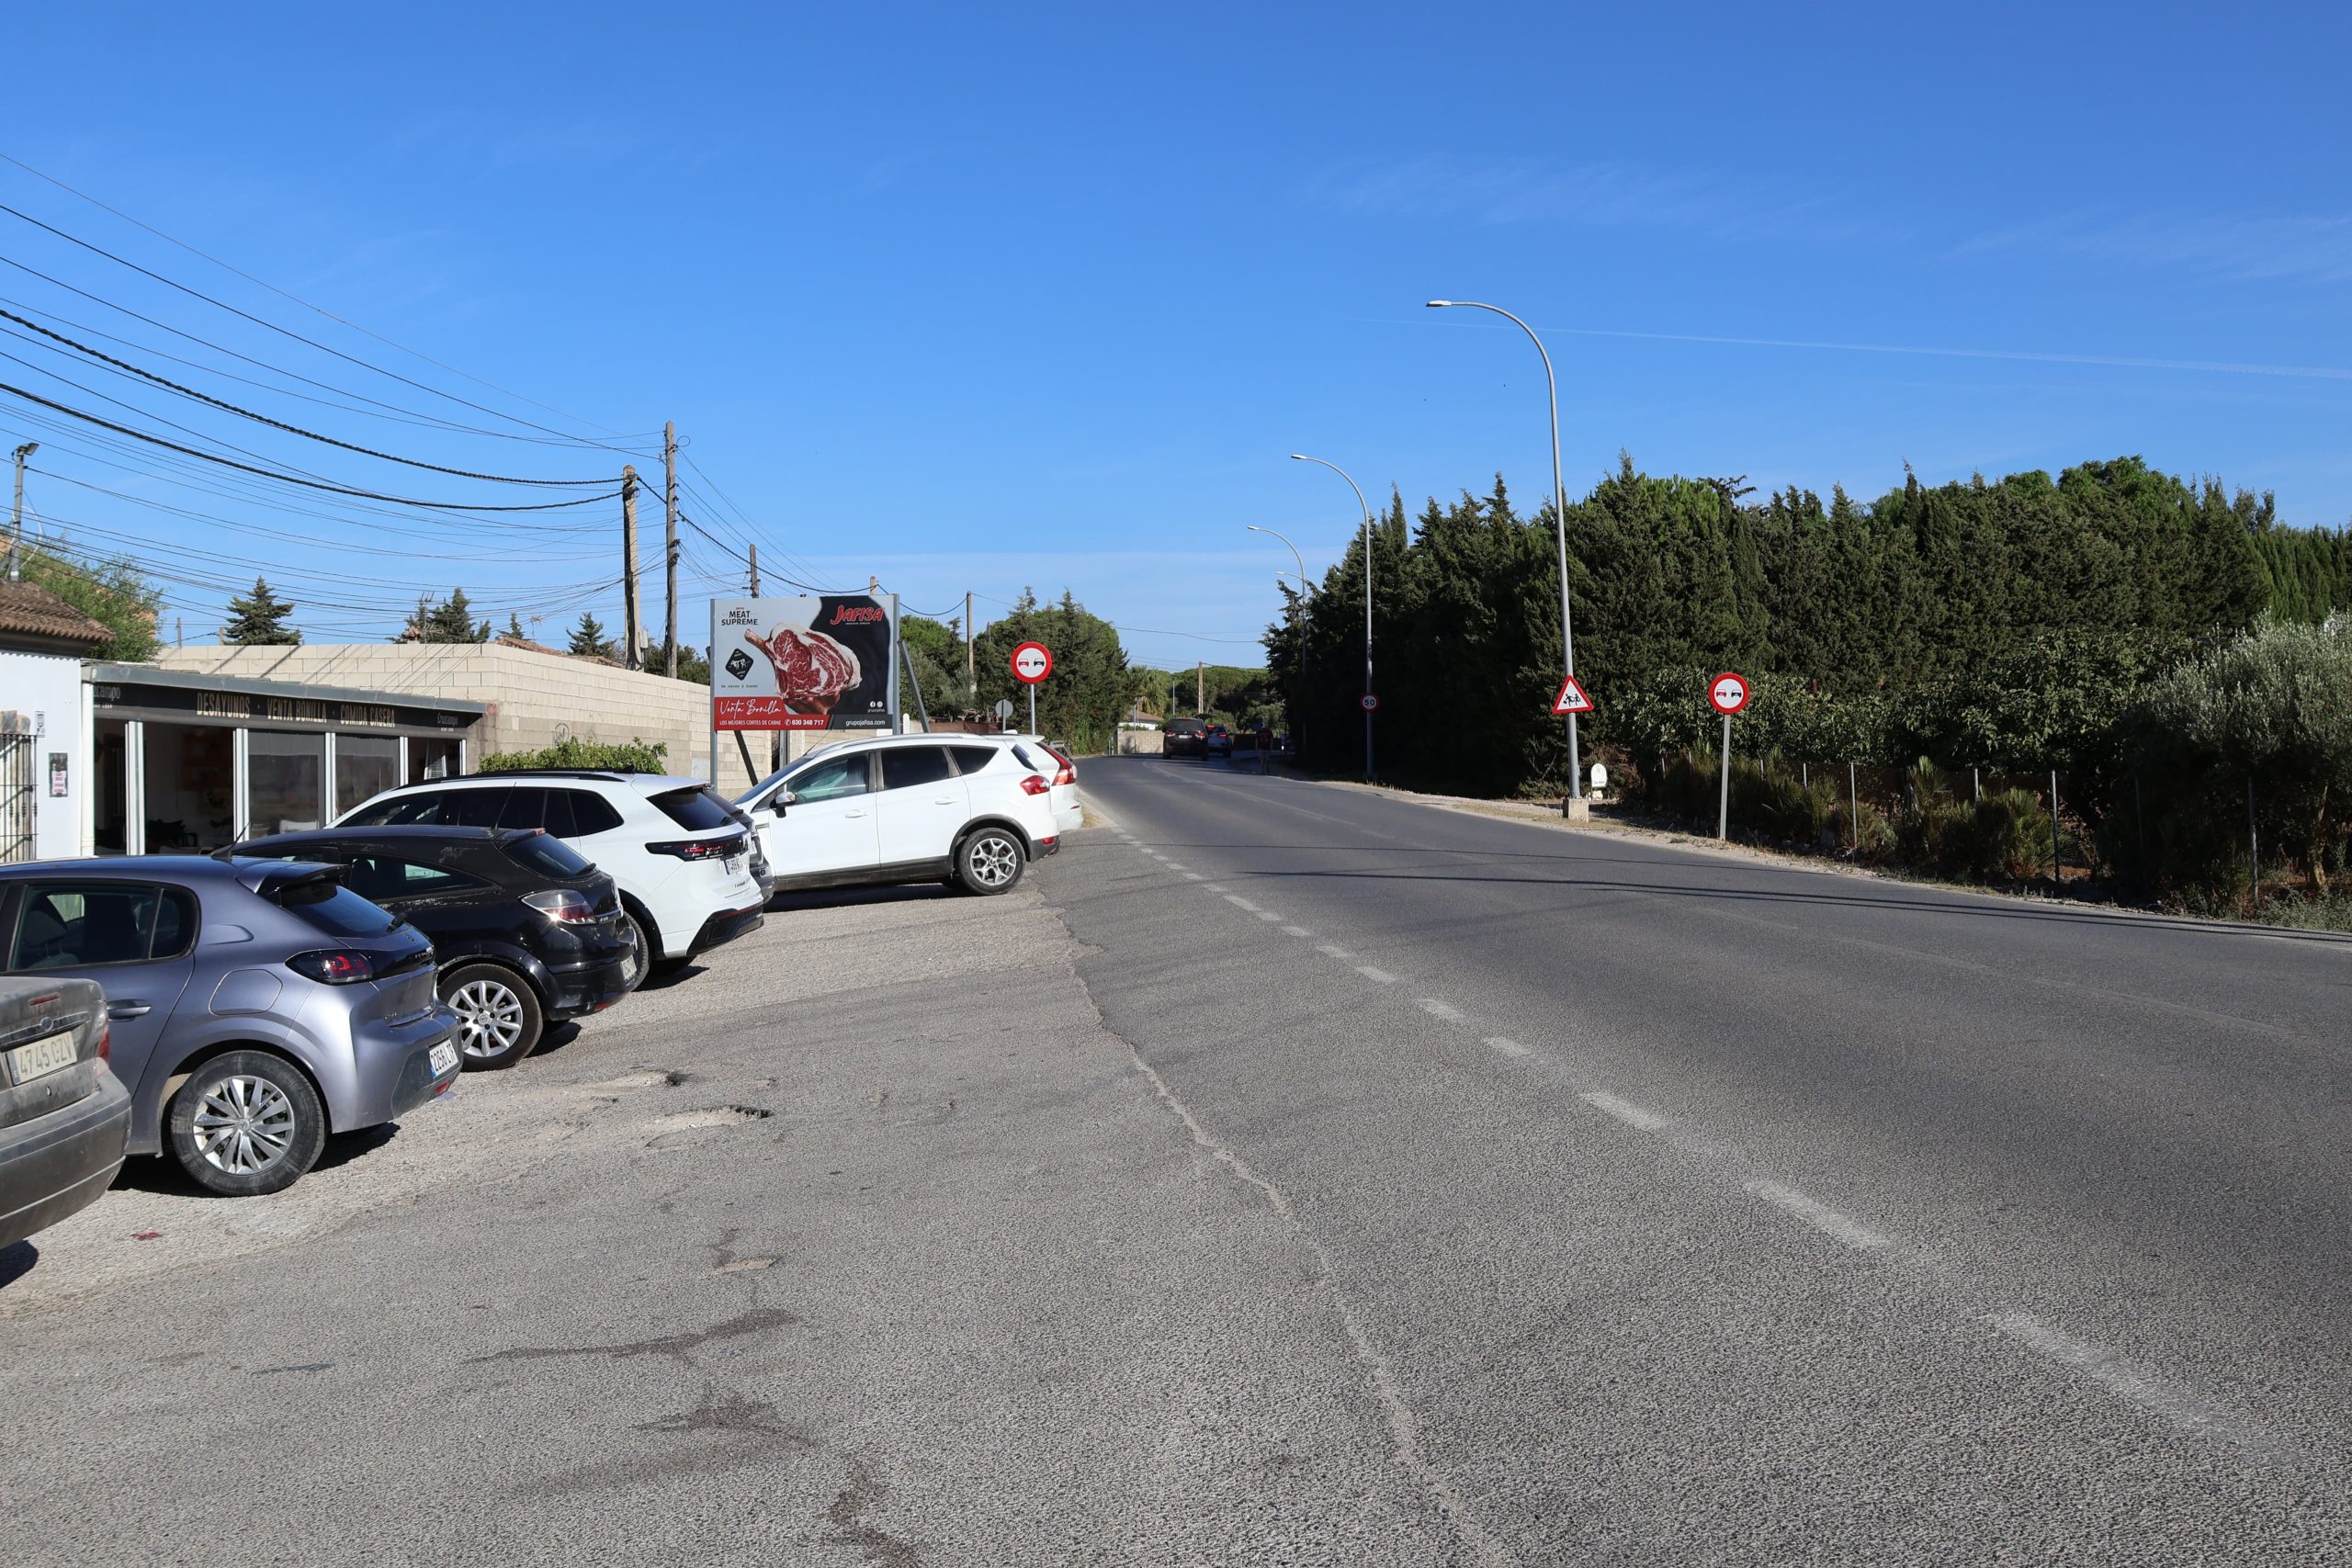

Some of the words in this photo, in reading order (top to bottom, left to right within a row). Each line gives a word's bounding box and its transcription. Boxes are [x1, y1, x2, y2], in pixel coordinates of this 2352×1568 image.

[721, 618, 758, 626] SUPREME
[729, 610, 751, 618] MEAT
[197, 692, 251, 718] DESAYUNOS
[266, 697, 293, 721] VENTA
[295, 699, 327, 724] BONILLA
[340, 704, 368, 726] COMIDA
[369, 705, 396, 728] CASERA
[719, 699, 745, 720] Venta
[746, 698, 782, 716] Bonilla
